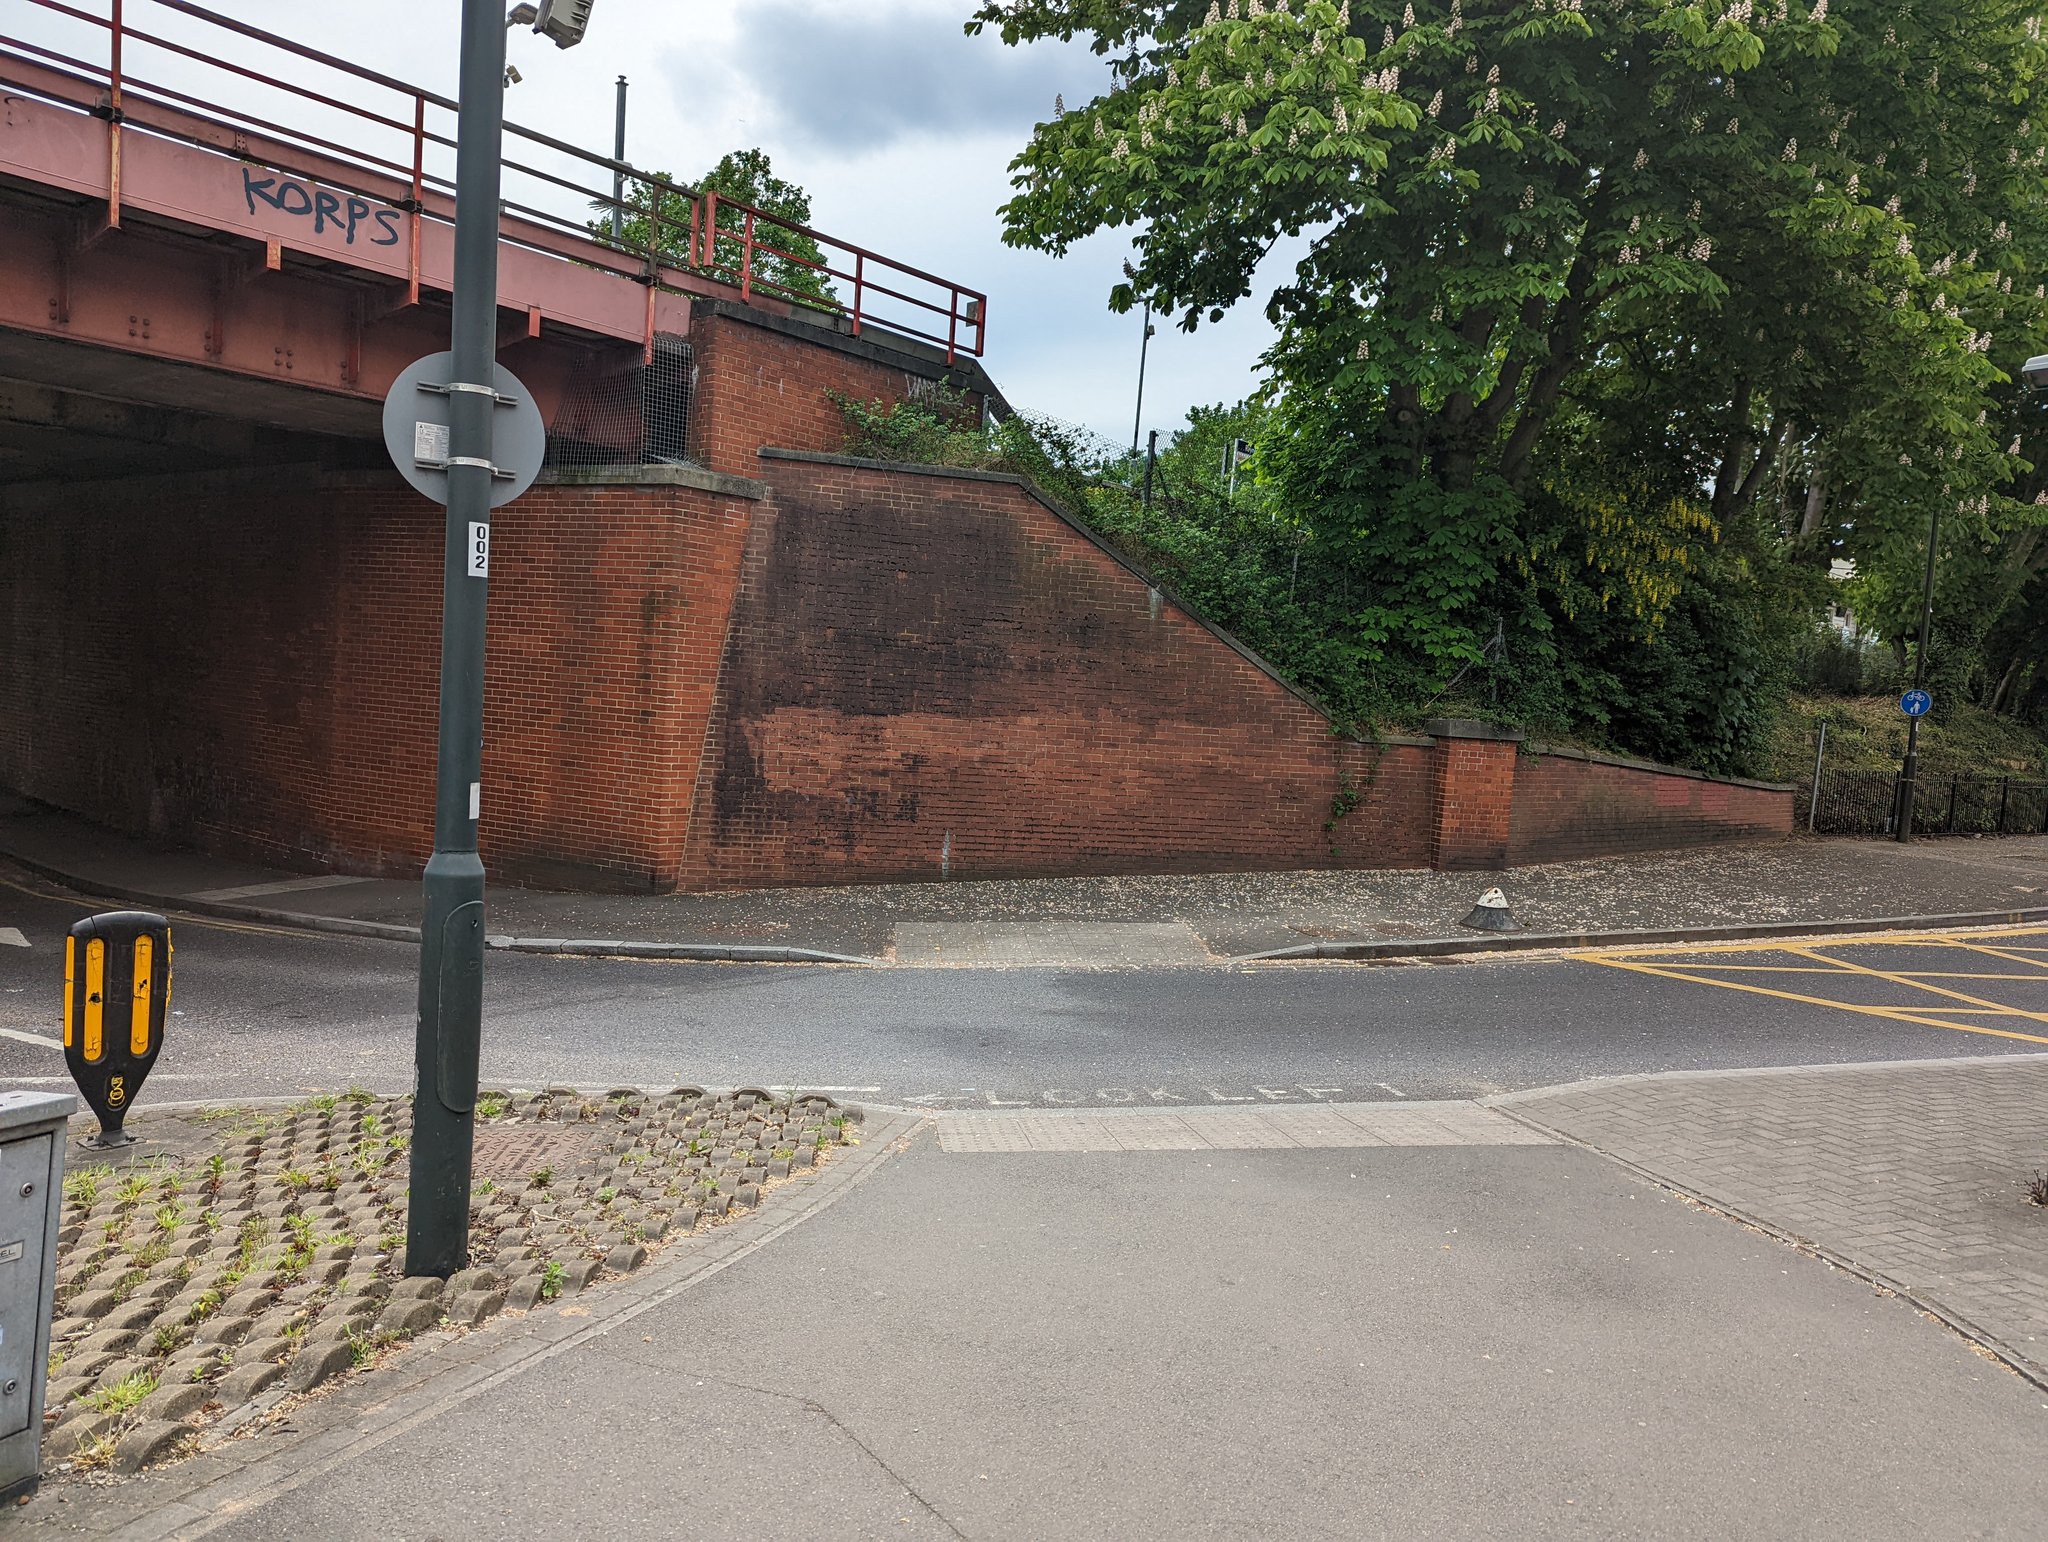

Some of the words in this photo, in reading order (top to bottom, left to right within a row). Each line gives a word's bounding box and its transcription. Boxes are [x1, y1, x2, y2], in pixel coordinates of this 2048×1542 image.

[242, 167, 400, 245] KORPS
[475, 526, 486, 569] 002
[985, 1087, 1185, 1105] LOOK
[1200, 1082, 1405, 1101] LEFT
